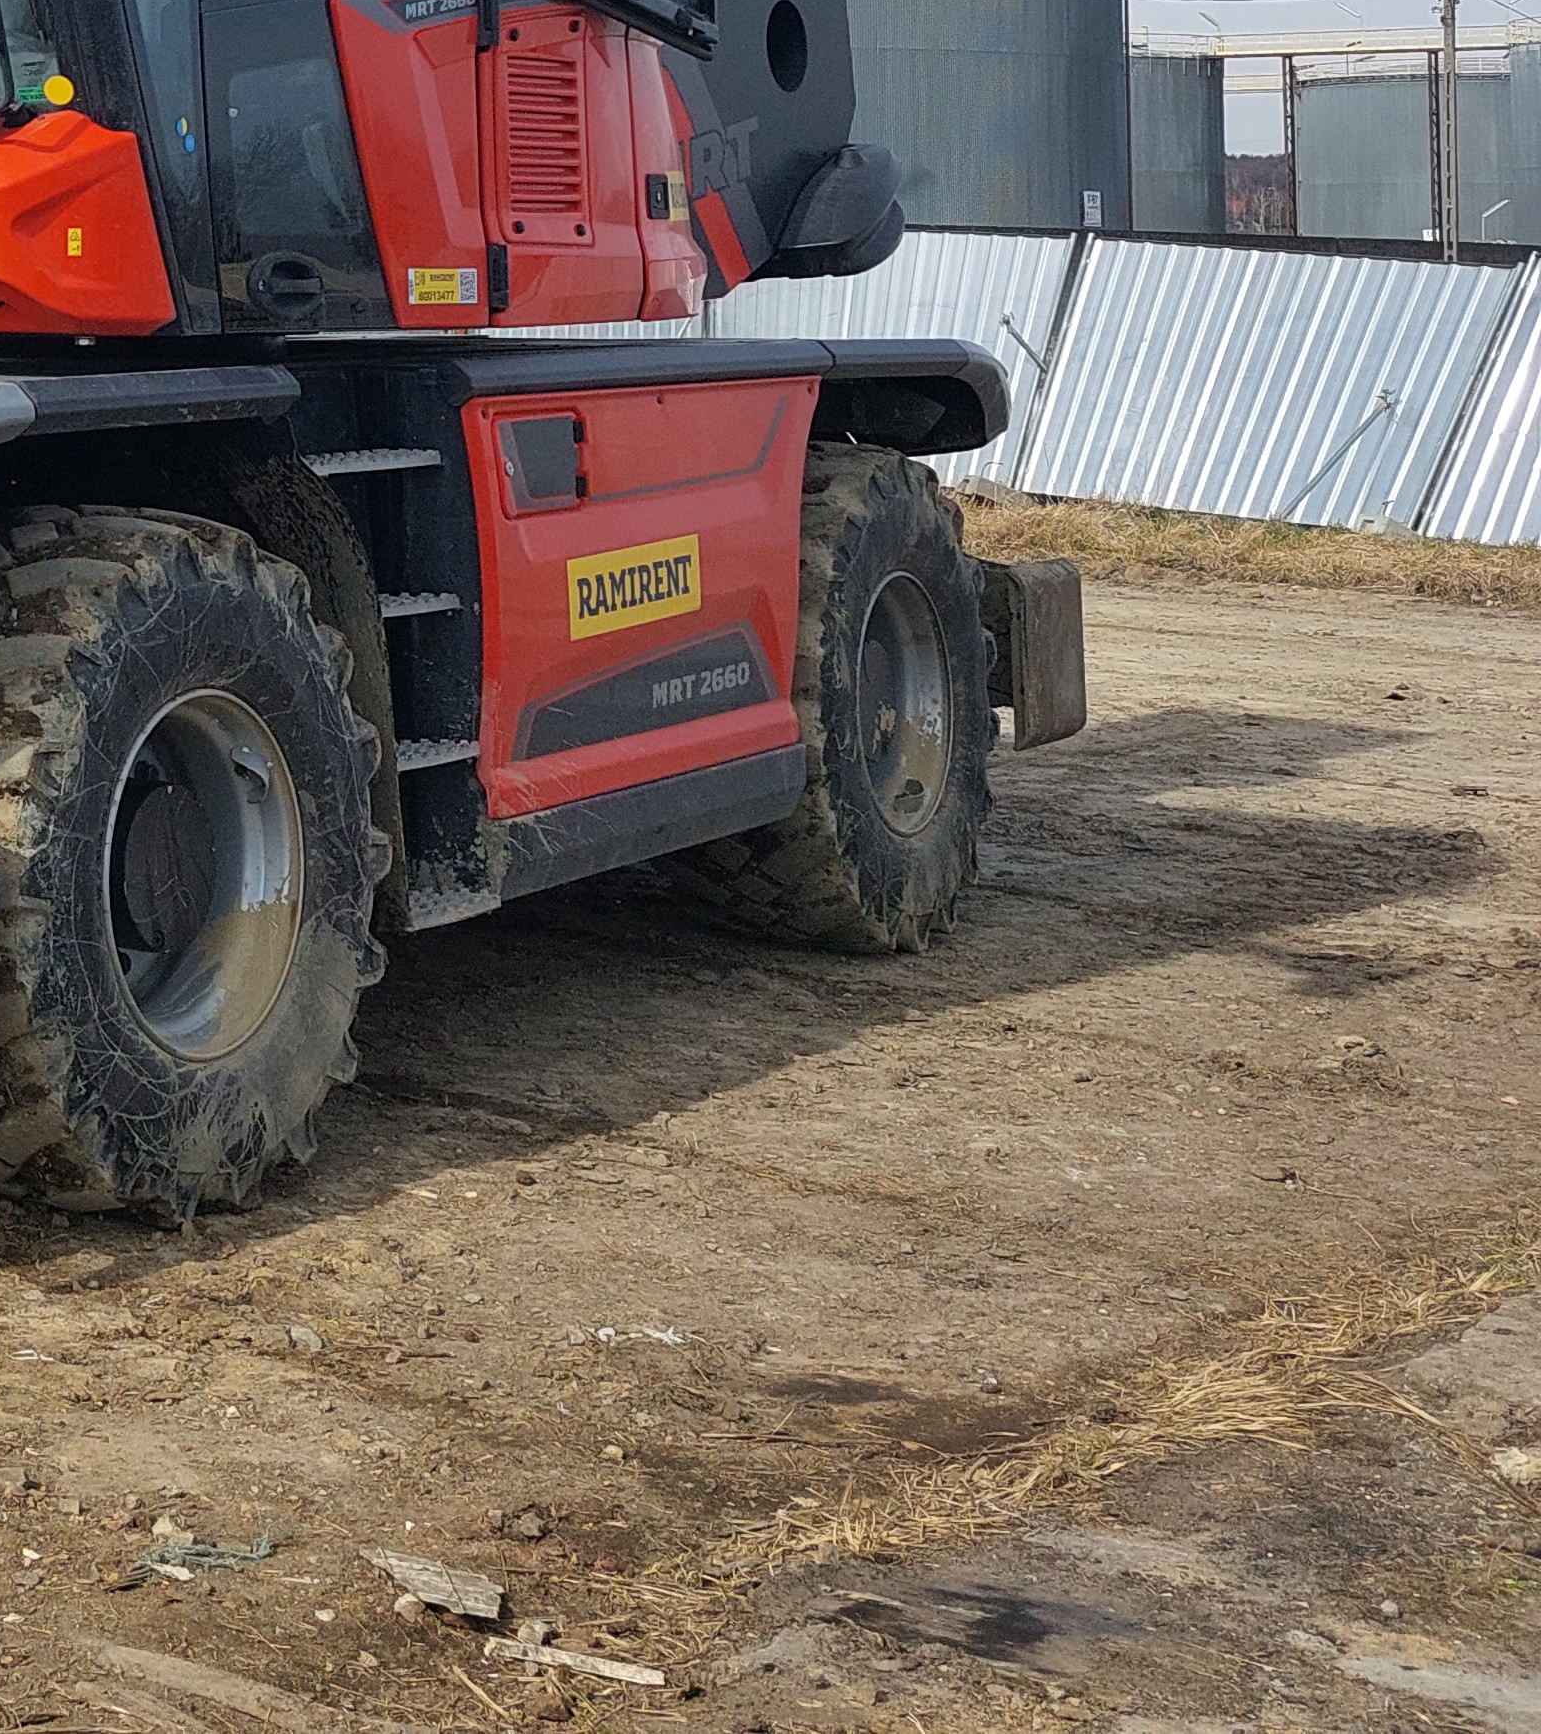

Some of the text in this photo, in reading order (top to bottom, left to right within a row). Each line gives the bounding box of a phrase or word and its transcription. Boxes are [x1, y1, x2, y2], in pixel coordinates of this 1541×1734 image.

[679, 115, 759, 200] RT
[576, 554, 692, 620] RAMIRENT
[652, 661, 751, 709] MRT 2660
